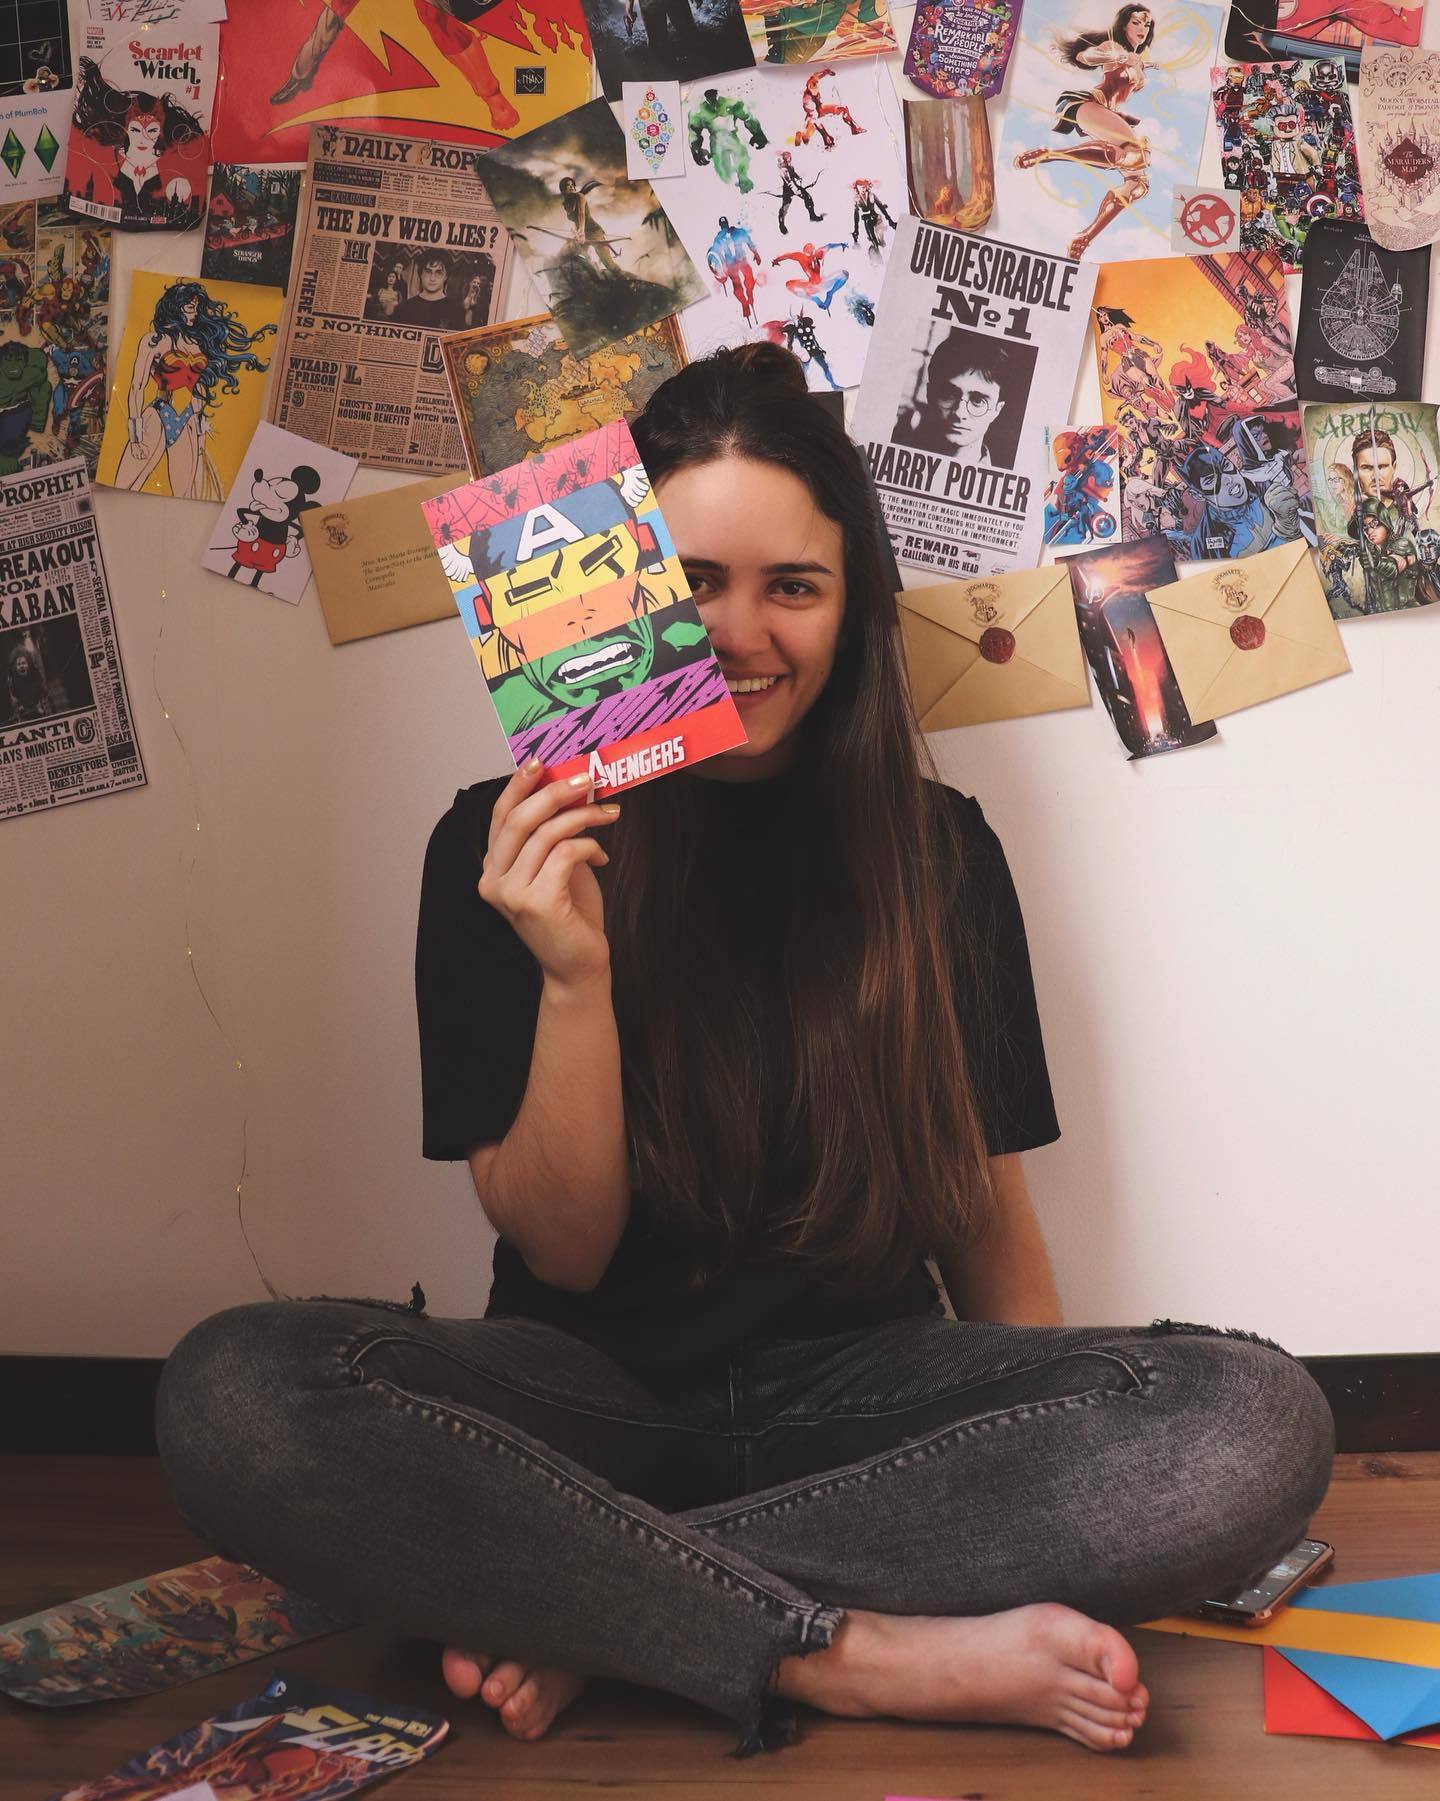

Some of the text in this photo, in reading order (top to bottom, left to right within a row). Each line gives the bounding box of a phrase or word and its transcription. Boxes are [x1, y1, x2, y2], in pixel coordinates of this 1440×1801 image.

[128, 41, 203, 62] Scarlet
[938, 53, 978, 69] SOMETHING
[134, 60, 201, 85] Witch
[185, 86, 200, 100] #1
[343, 136, 412, 163] DAILY
[317, 206, 353, 233] THE
[357, 211, 394, 238] BOY
[399, 216, 443, 243] WHO
[910, 226, 1079, 312] UNDESIRABLE
[297, 270, 319, 314] THERE
[295, 316, 422, 342] IS NOTHING!
[290, 357, 338, 374] WIZARD
[295, 370, 336, 386] PRISON
[337, 408, 410, 426] HOUSING BENEFITS
[375, 402, 411, 415] DEMAND
[413, 412, 439, 423] WITCH
[867, 442, 1031, 513] HARRY POTTER
[887, 494, 899, 503] THE
[901, 497, 929, 511] MINISTRY
[931, 503, 938, 512] OF
[940, 505, 960, 518] MAGIC
[961, 509, 1002, 527] IMMEDIATELY
[1004, 519, 1010, 528] IF
[1012, 522, 1024, 531] YOU
[887, 504, 926, 520] INFORMATION
[927, 512, 964, 528] CONCERNING
[966, 521, 975, 530] HIS
[7, 540, 17, 550] AT
[18, 534, 35, 547] HIGH
[36, 527, 68, 543] SECURITY
[69, 519, 93, 533] PRISON
[892, 514, 915, 526] REPORT
[917, 520, 933, 530] WILL
[935, 523, 959, 536] RESULT
[961, 528, 968, 537] IN
[905, 535, 959, 557] REWARD
[901, 547, 935, 564] GALLEONS
[937, 556, 946, 566] ON
[948, 558, 960, 569] HIS
[961, 561, 979, 574] HEAD
[92, 575, 107, 615] SEVERAL
[24, 735, 75, 760] MINISTER
[47, 757, 108, 780] DEMENTORS
[586, 735, 685, 805] AVENGERS
[49, 774, 84, 790] PAGES 3/5
